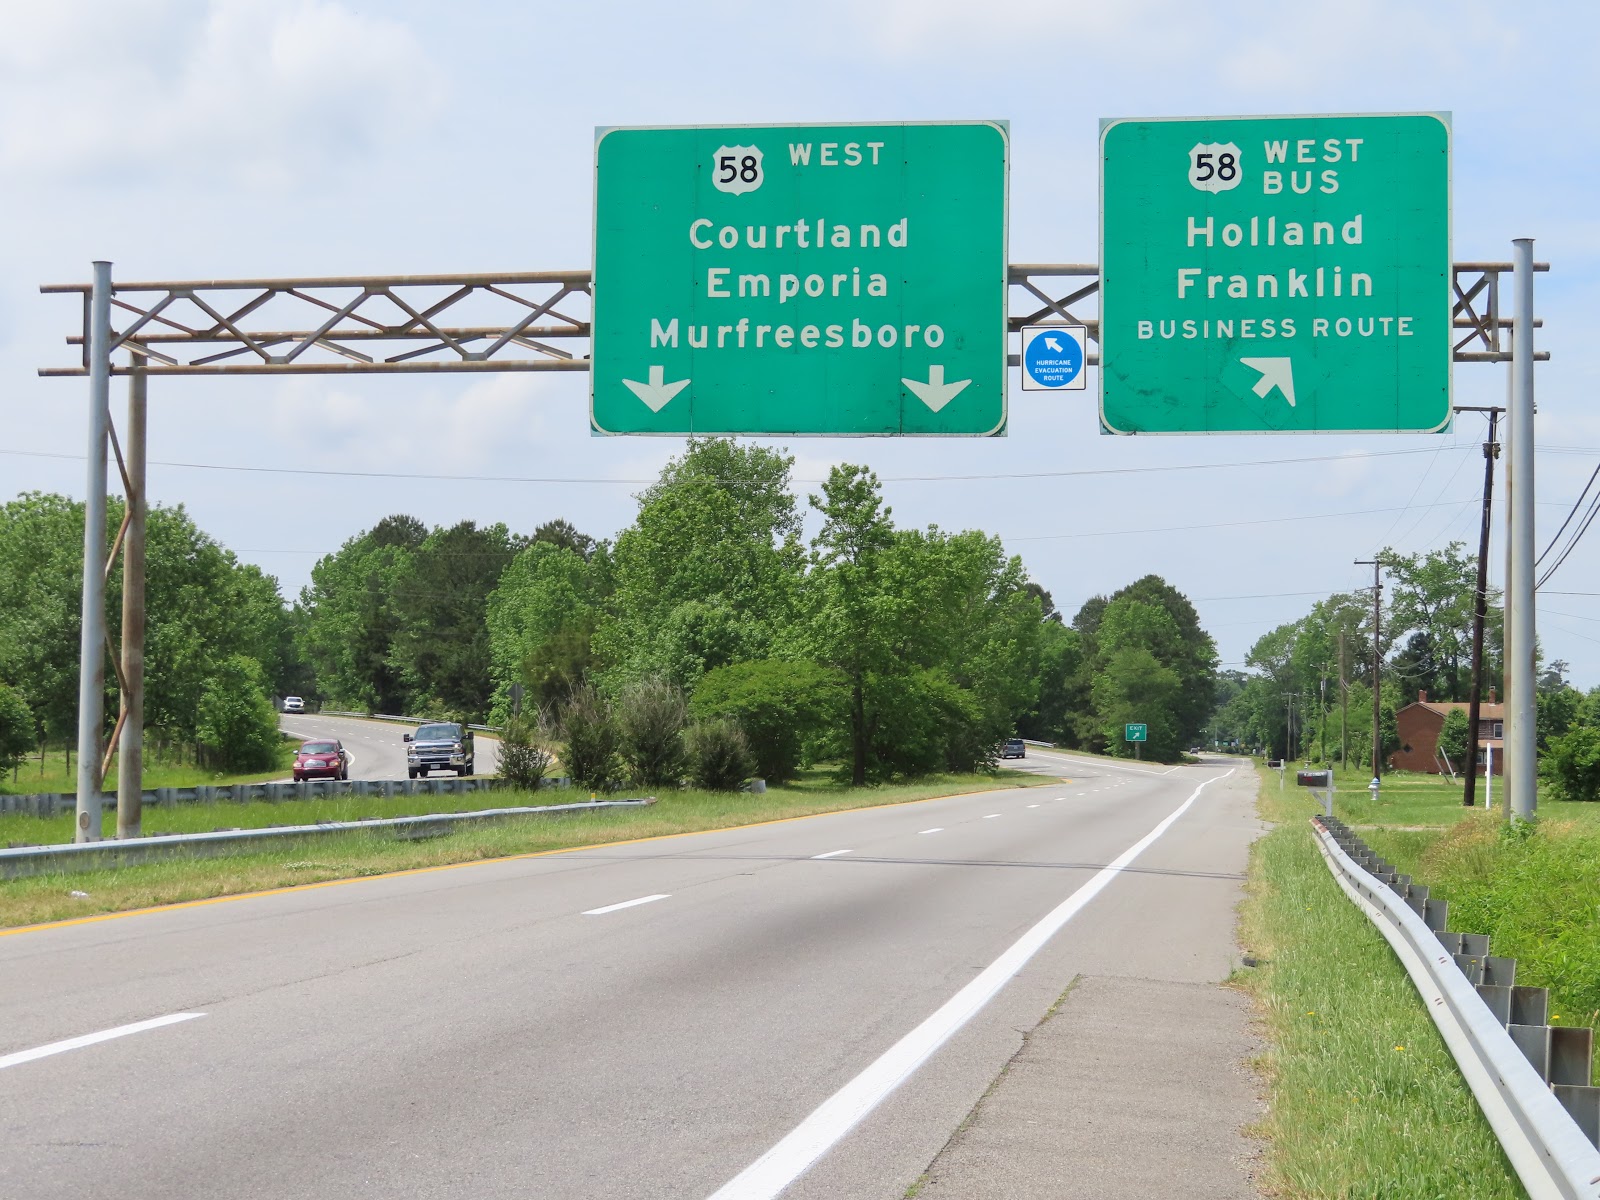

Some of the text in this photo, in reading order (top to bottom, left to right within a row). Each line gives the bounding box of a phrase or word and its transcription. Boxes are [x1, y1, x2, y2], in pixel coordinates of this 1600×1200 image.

[719, 142, 885, 184] 58 WEST
[1196, 138, 1364, 182] 58 WEST
[1263, 169, 1339, 195] BUS
[689, 217, 908, 250] Courtland
[1187, 214, 1363, 247] Holland
[707, 267, 888, 304] Emporia
[1177, 265, 1373, 299] Franklin
[650, 317, 945, 349] Murfreesboro
[1137, 316, 1414, 340] BUSINESS ROUTE
